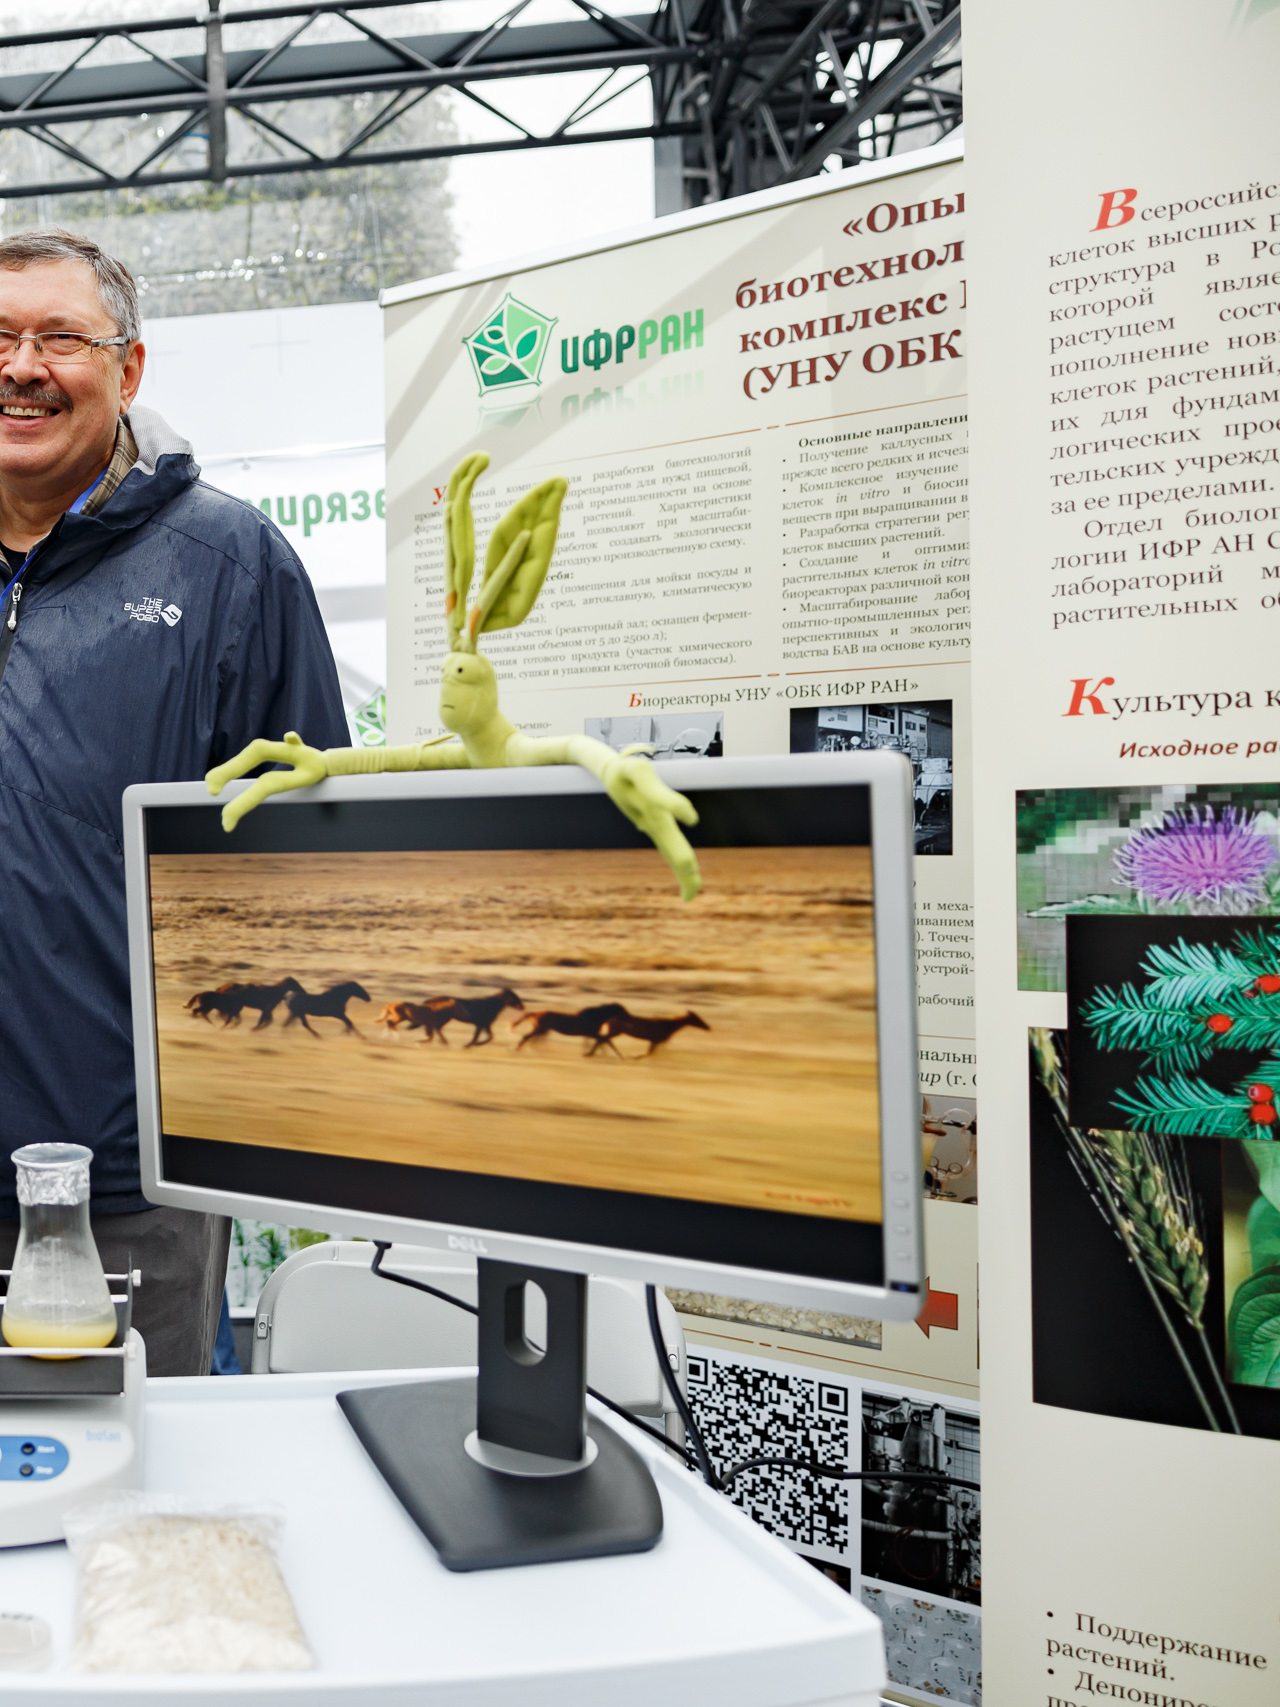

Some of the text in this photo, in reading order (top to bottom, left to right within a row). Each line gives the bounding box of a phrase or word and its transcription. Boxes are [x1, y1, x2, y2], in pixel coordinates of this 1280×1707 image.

[1049, 217, 1256, 268] клеток высших
[736, 241, 964, 308] биотехнол
[1049, 260, 1175, 295] структура
[1206, 253, 1220, 266] в
[1049, 288, 1154, 322] которой
[740, 293, 947, 353] комплекс
[1050, 316, 1175, 354] растущем
[743, 329, 963, 400] (УНУ ОБК
[1050, 340, 1208, 377] пополнение
[1050, 380, 1136, 404] клеток
[1051, 389, 1280, 432] их для фундам
[799, 427, 872, 448] Основные
[800, 432, 953, 464] Получение каллусных
[1050, 428, 1201, 460] логических
[666, 447, 751, 468] биотехнологий
[782, 453, 924, 482] прежде всего редких и
[637, 478, 656, 488] для
[694, 484, 706, 493] на
[712, 478, 752, 490] основе
[800, 463, 959, 494] Комплексное изучение
[1050, 460, 1165, 488] тельских
[659, 492, 751, 513] Характеристики
[782, 486, 911, 511] клеток in vitro и
[1051, 478, 1274, 514] за ее пределами.
[657, 517, 677, 528] при
[782, 512, 832, 526] веществ
[836, 510, 858, 522] при
[863, 494, 956, 516] выращивании
[674, 522, 751, 539] экологически
[800, 513, 940, 538] Разработка стратегии
[1084, 517, 1163, 538] Отдел
[782, 528, 945, 555] клеток высших растений.
[1051, 533, 1254, 569] логии ИФР АН
[800, 551, 889, 568] Создание и
[631, 578, 650, 587] для
[697, 567, 738, 580] посуды
[745, 566, 751, 574] и
[782, 569, 869, 587] растительных
[874, 564, 918, 575] клеток
[923, 560, 935, 571] in
[1052, 564, 1223, 598] лабораторий
[782, 584, 867, 600] биореакторах
[870, 575, 942, 594] различной
[124, 603, 161, 615] SUPER
[143, 597, 163, 607] THE
[800, 595, 918, 613] Масштабирование
[1053, 596, 1238, 629] растительных
[782, 610, 939, 629] опытно-промышленных
[608, 636, 620, 644] до
[624, 633, 650, 644] 2500
[679, 639, 752, 653] химического
[782, 630, 879, 646] перспективных
[891, 628, 898, 636] и
[782, 647, 829, 659] водства
[833, 645, 858, 656] БАВ
[863, 645, 877, 653] на
[881, 640, 925, 652] основе
[629, 678, 918, 709] Биореакторы УНУ «ОБК ИФР РАН»
[1062, 676, 1253, 721] Культура
[1119, 739, 1238, 759] Исходное
[937, 902, 974, 911] меха-
[928, 932, 974, 943] Точеч-
[923, 964, 974, 976] устрой-
[918, 994, 974, 1007] рабочий
[1075, 1611, 1267, 1670] Поддержание
[1046, 1639, 1175, 1681] растений.
